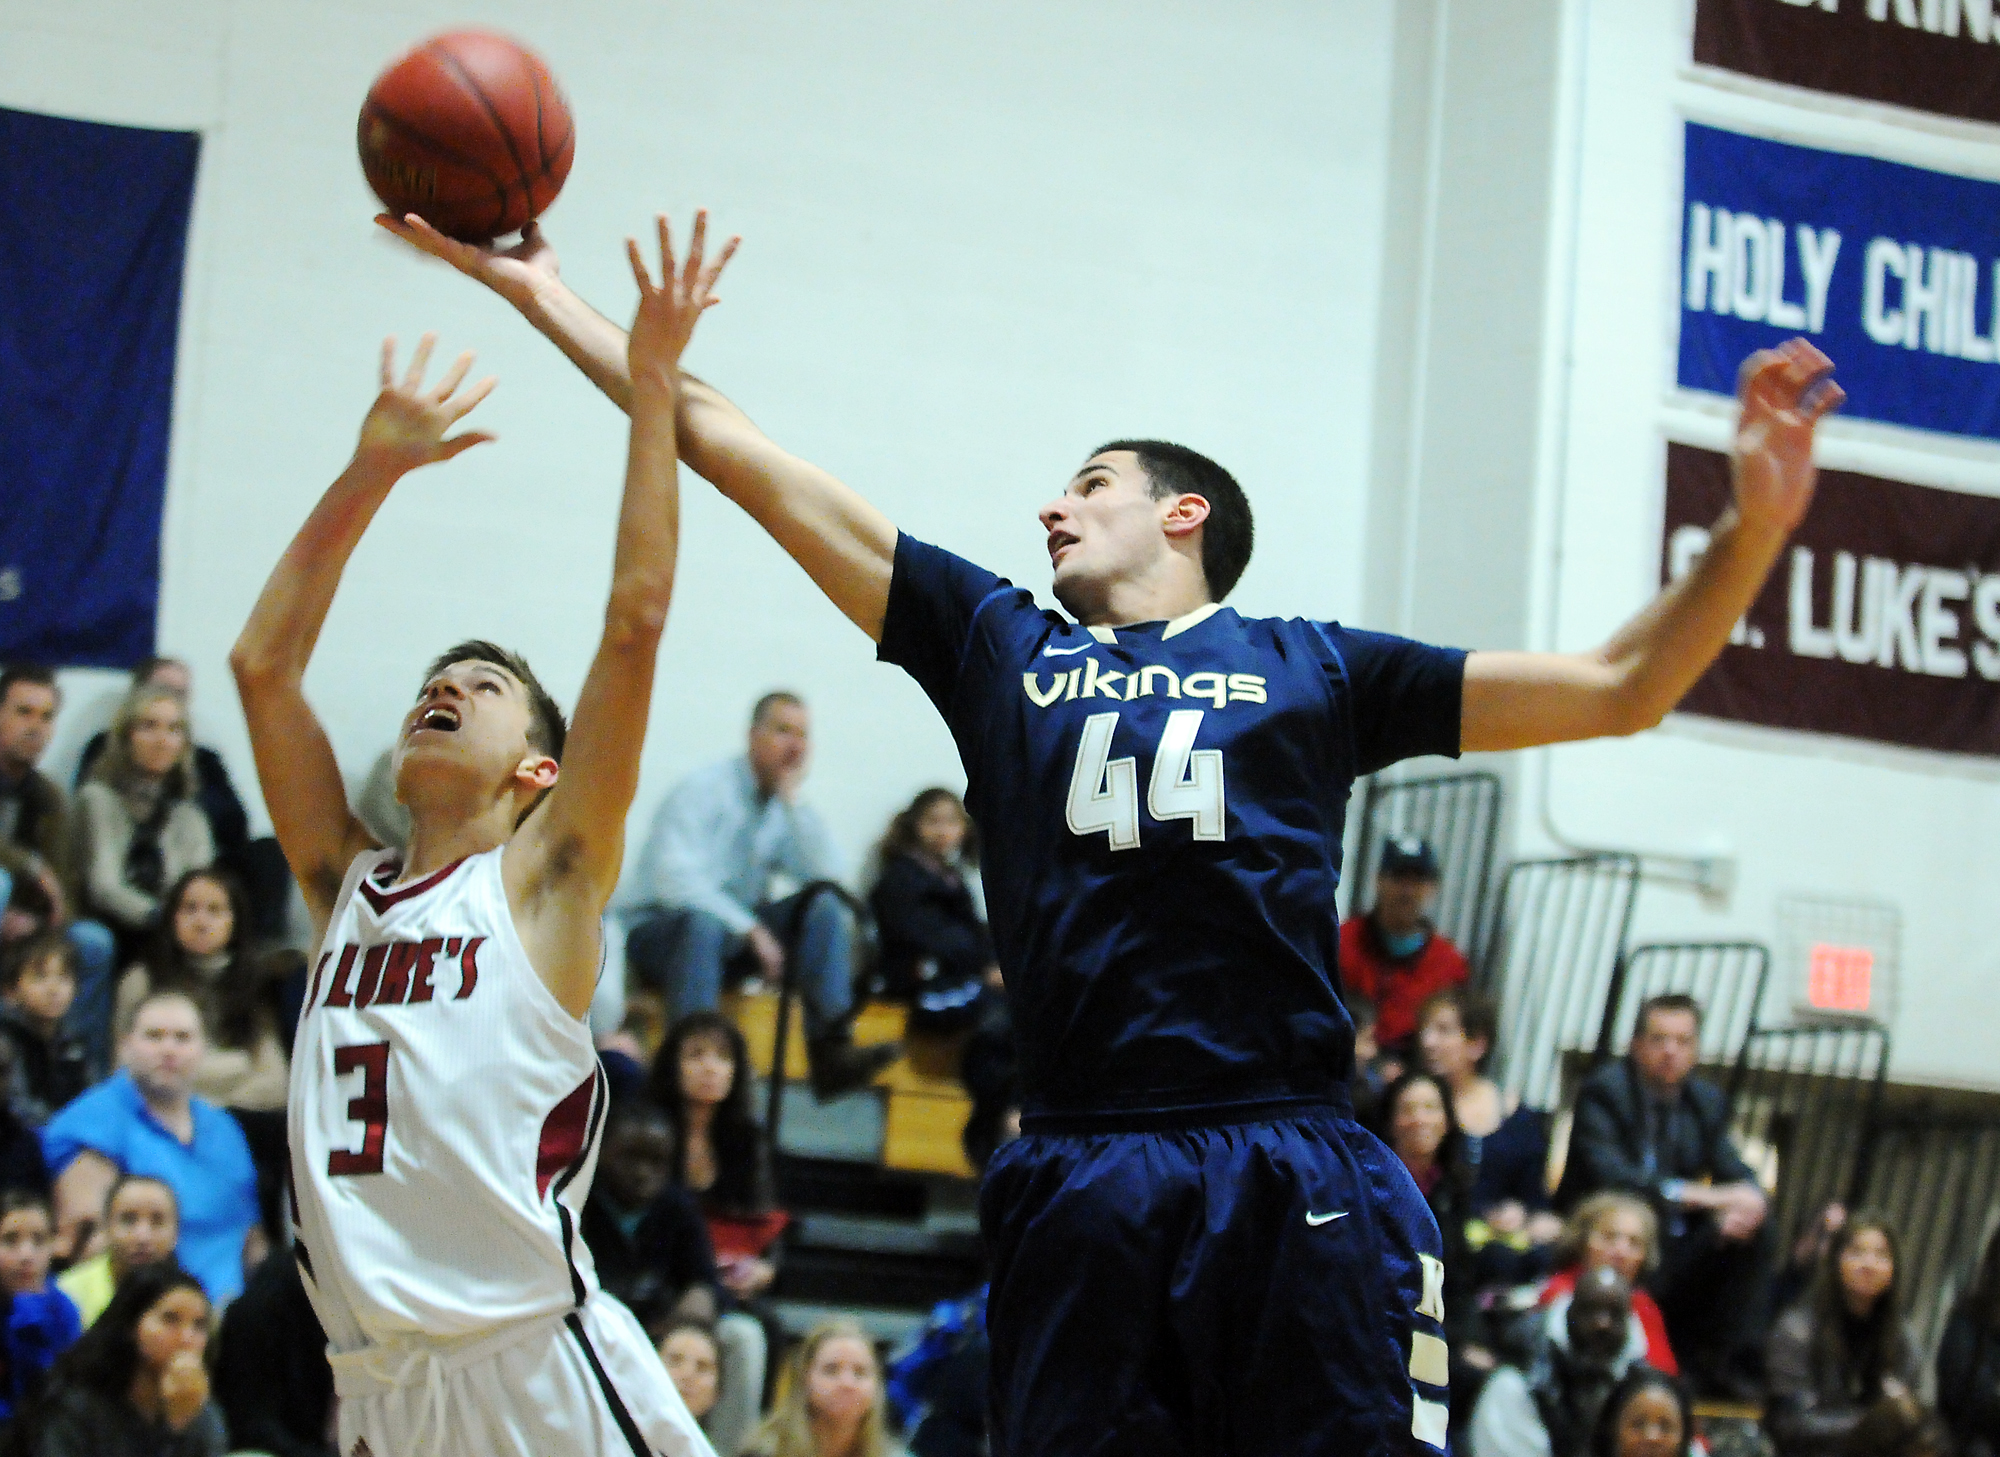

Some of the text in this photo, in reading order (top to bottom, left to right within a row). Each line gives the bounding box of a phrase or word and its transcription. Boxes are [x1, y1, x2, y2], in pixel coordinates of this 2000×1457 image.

[1686, 202, 2000, 364] HOLY CHIL
[1066, 710, 1226, 850] 44
[323, 937, 486, 1009] LUKE'S
[328, 1042, 390, 1175] 3
